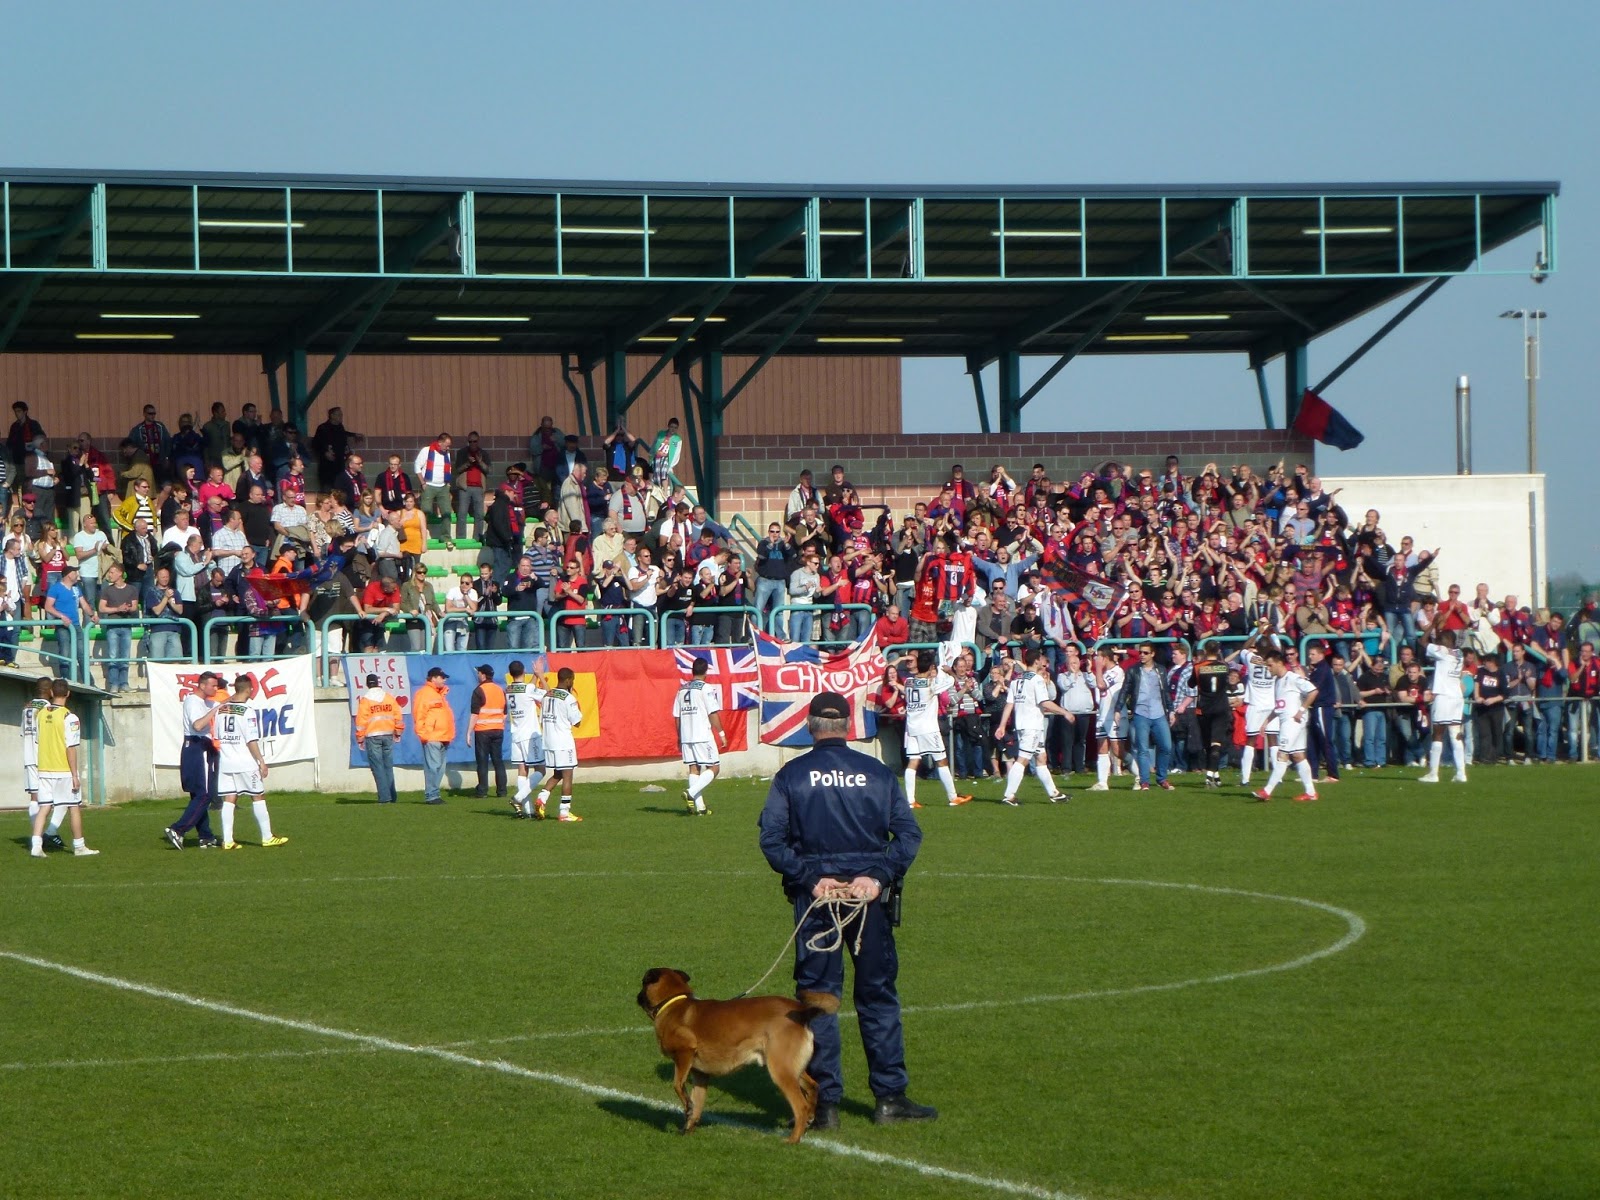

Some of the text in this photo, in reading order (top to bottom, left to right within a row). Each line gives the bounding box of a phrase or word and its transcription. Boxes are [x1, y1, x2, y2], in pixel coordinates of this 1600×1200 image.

[354, 675, 405, 690] LEGE
[508, 694, 517, 709] 3
[683, 690, 692, 705] 4
[224, 715, 235, 732] 18
[809, 769, 867, 788] Police
